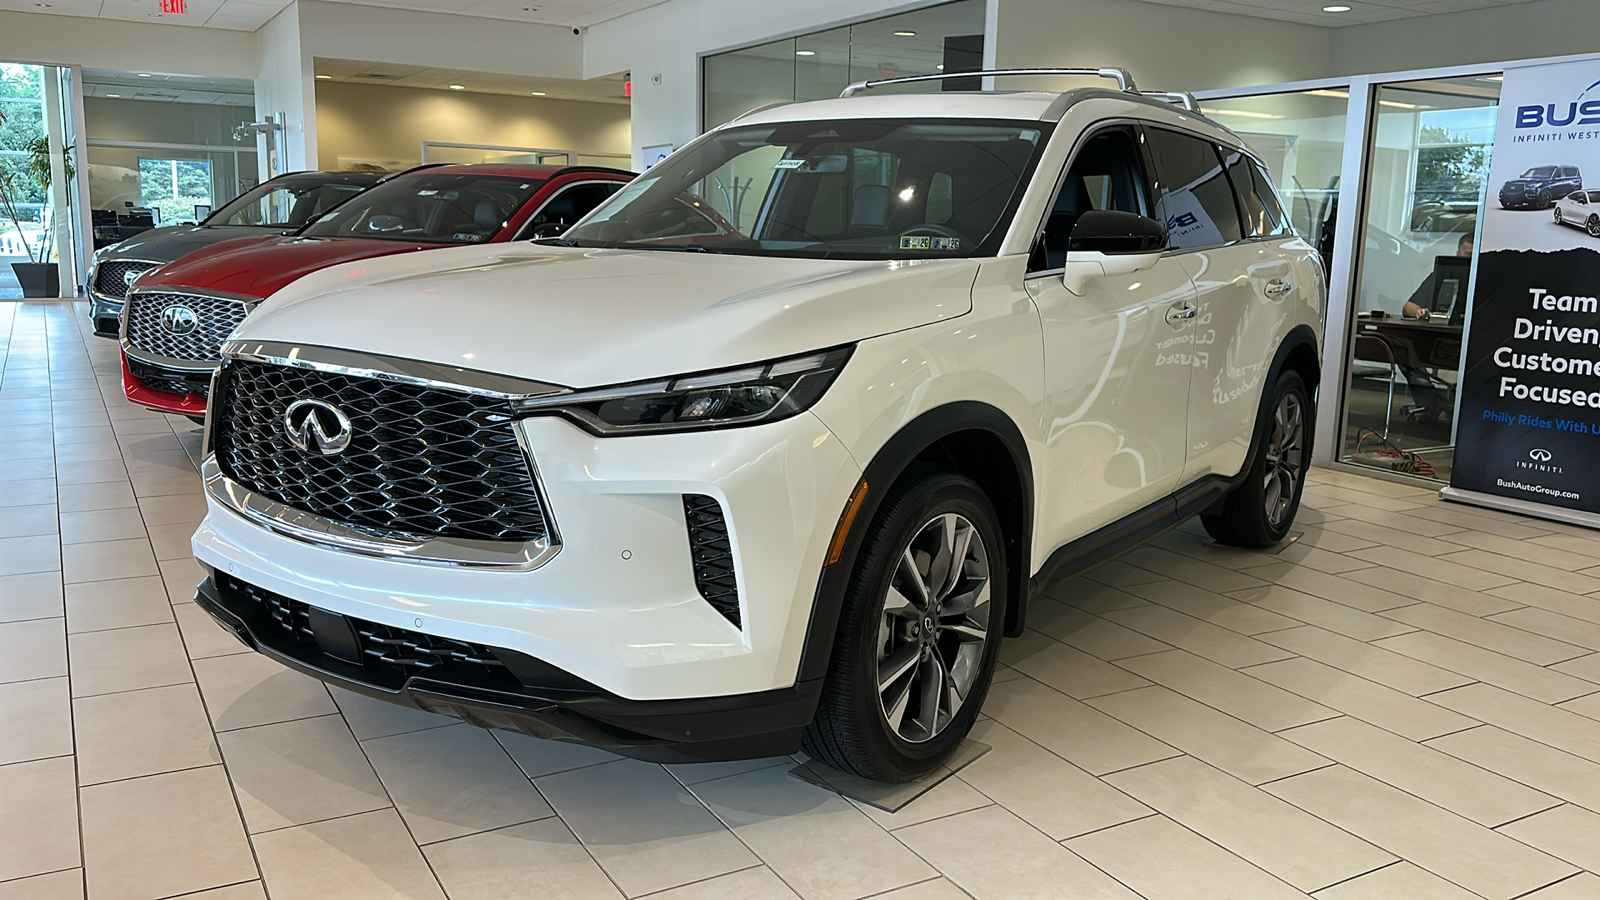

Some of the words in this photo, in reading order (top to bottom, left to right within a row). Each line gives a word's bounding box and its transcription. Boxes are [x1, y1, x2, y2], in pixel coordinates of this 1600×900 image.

[163, 0, 184, 14] EXIT
[1515, 101, 1600, 129] BUS
[1513, 133, 1562, 143] INFINITI
[1568, 131, 1600, 140] WEST
[1529, 288, 1598, 313] Team
[1482, 409, 1515, 426] Philly
[1518, 414, 1552, 429] Rides
[1555, 419, 1588, 434] With
[1516, 461, 1562, 474] INFINITI
[1497, 478, 1580, 500] BushAutoGroup.com
